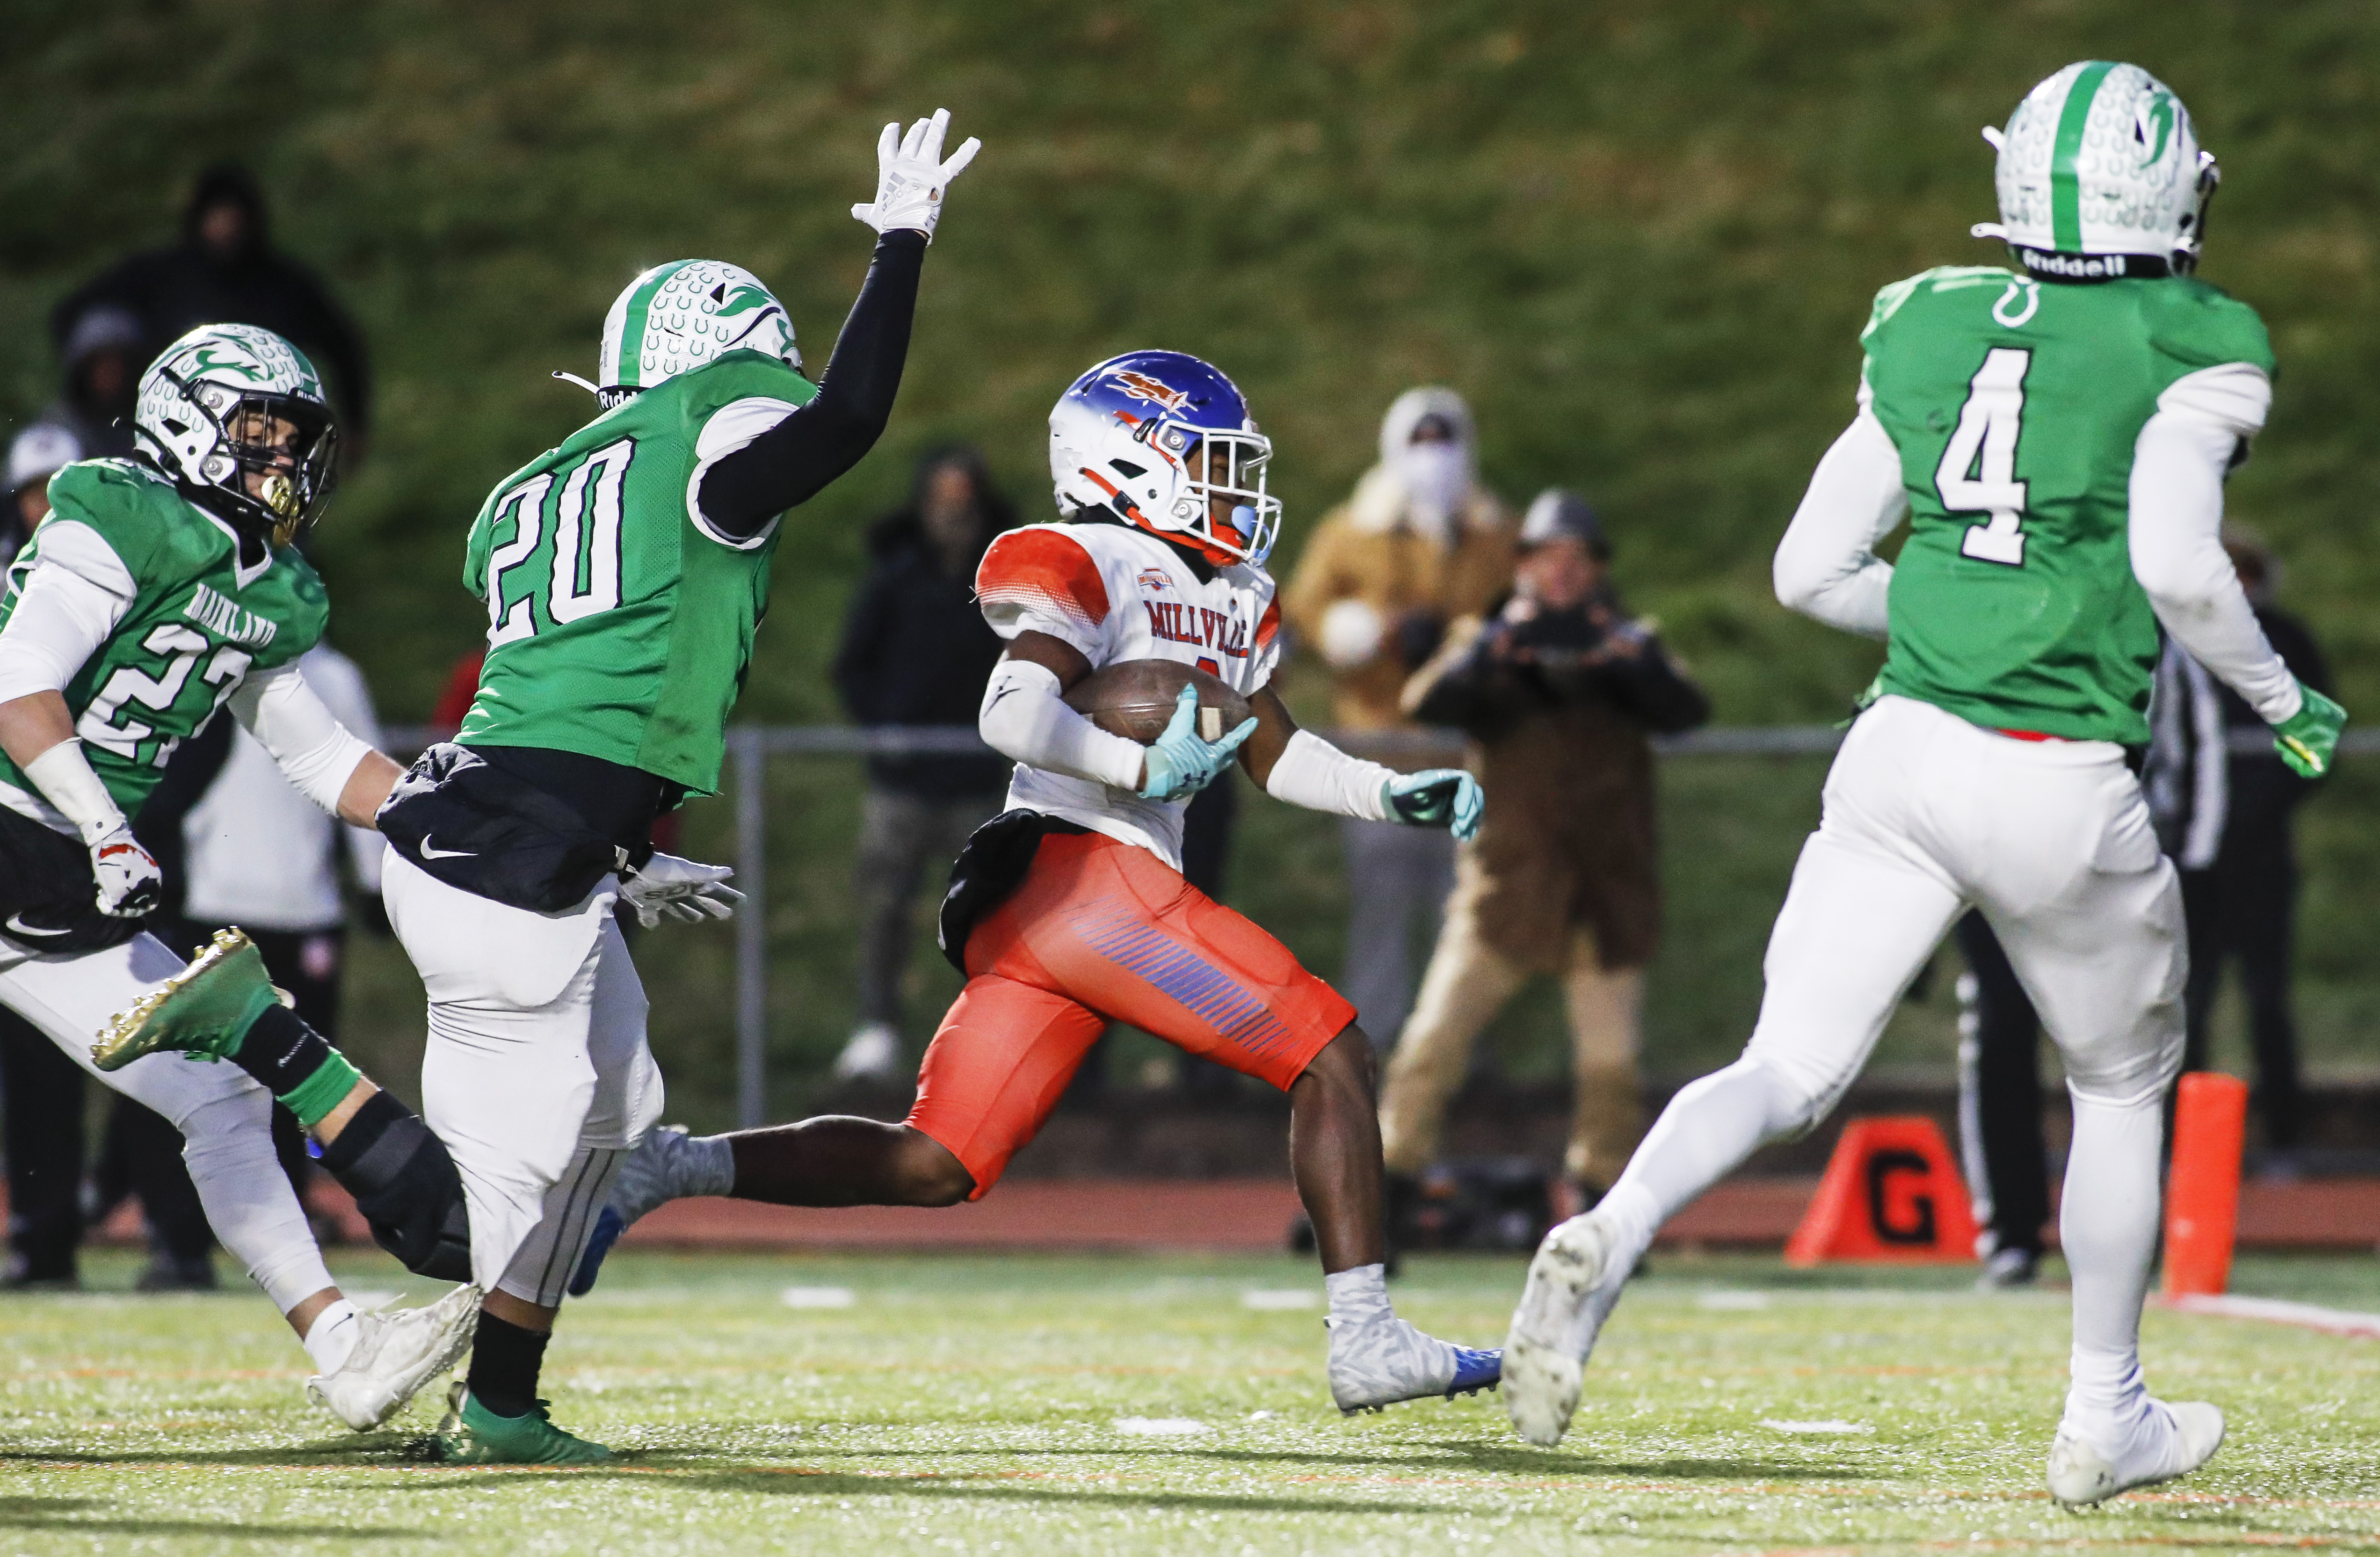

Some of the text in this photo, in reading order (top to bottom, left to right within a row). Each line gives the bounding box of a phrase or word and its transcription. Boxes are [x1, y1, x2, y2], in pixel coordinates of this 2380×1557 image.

[1935, 347, 2033, 567] 4
[183, 582, 277, 647] MAINLAND
[486, 435, 638, 652] 20
[1870, 1149, 1935, 1244] G
